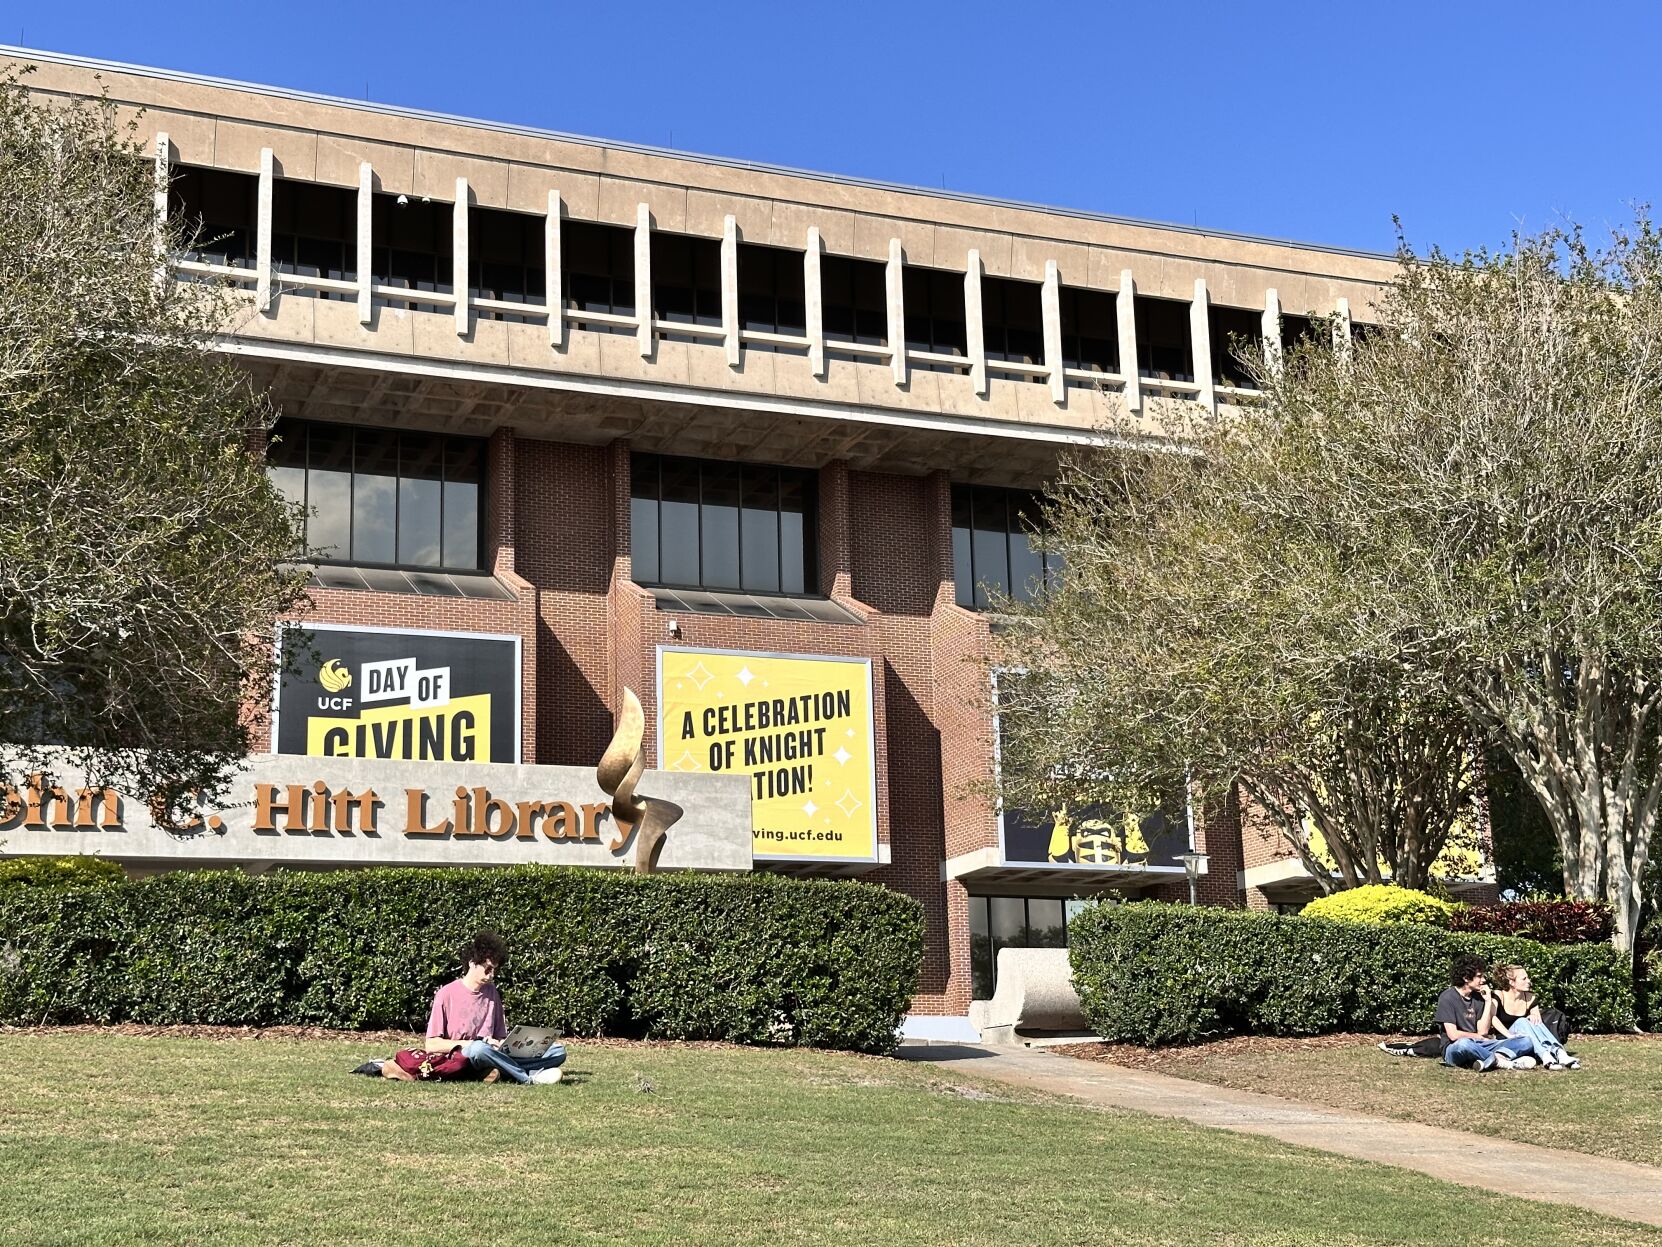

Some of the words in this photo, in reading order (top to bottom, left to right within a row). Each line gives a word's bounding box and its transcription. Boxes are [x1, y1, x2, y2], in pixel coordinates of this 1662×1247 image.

[318, 697, 352, 710] UCF
[369, 665, 409, 694] DAY
[418, 675, 443, 701] OF
[324, 710, 475, 761] GIVING
[682, 711, 695, 739] A
[703, 689, 851, 737] CELEBRATION
[709, 740, 736, 771] OF
[744, 727, 826, 766] KNIGHT
[751, 764, 813, 800] TION!
[251, 780, 381, 831] Hitt
